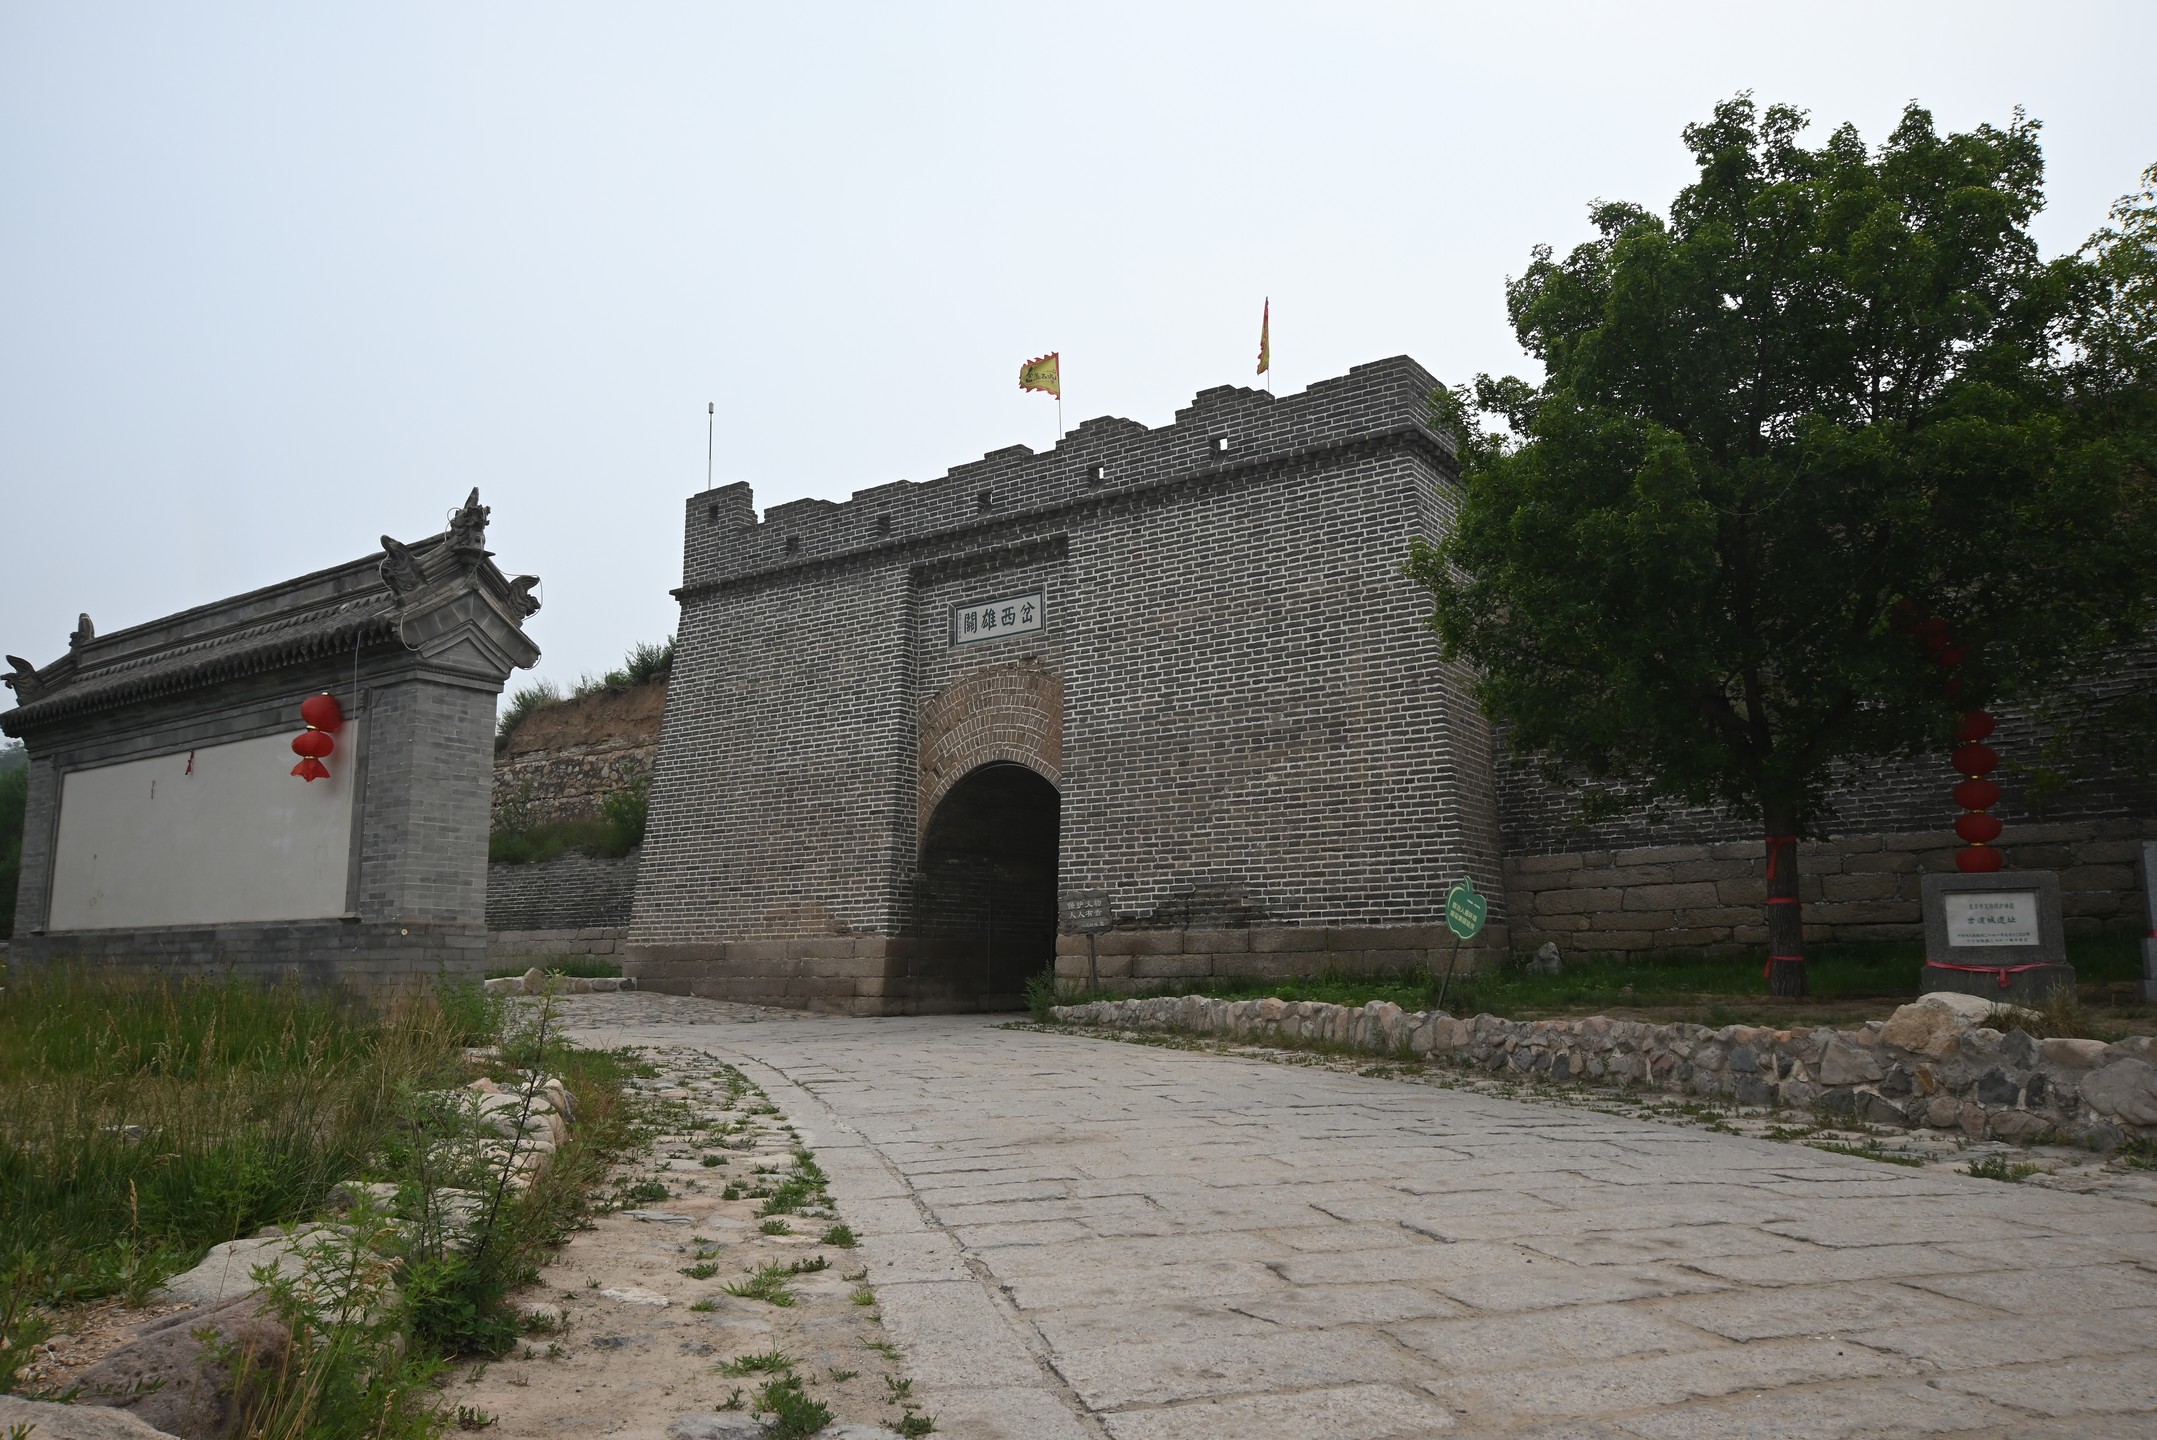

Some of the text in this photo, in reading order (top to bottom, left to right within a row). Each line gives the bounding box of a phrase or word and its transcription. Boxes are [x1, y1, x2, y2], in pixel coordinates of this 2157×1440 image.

[1067, 900, 1102, 910] 保护文物
[1070, 909, 1102, 919] 人人有责
